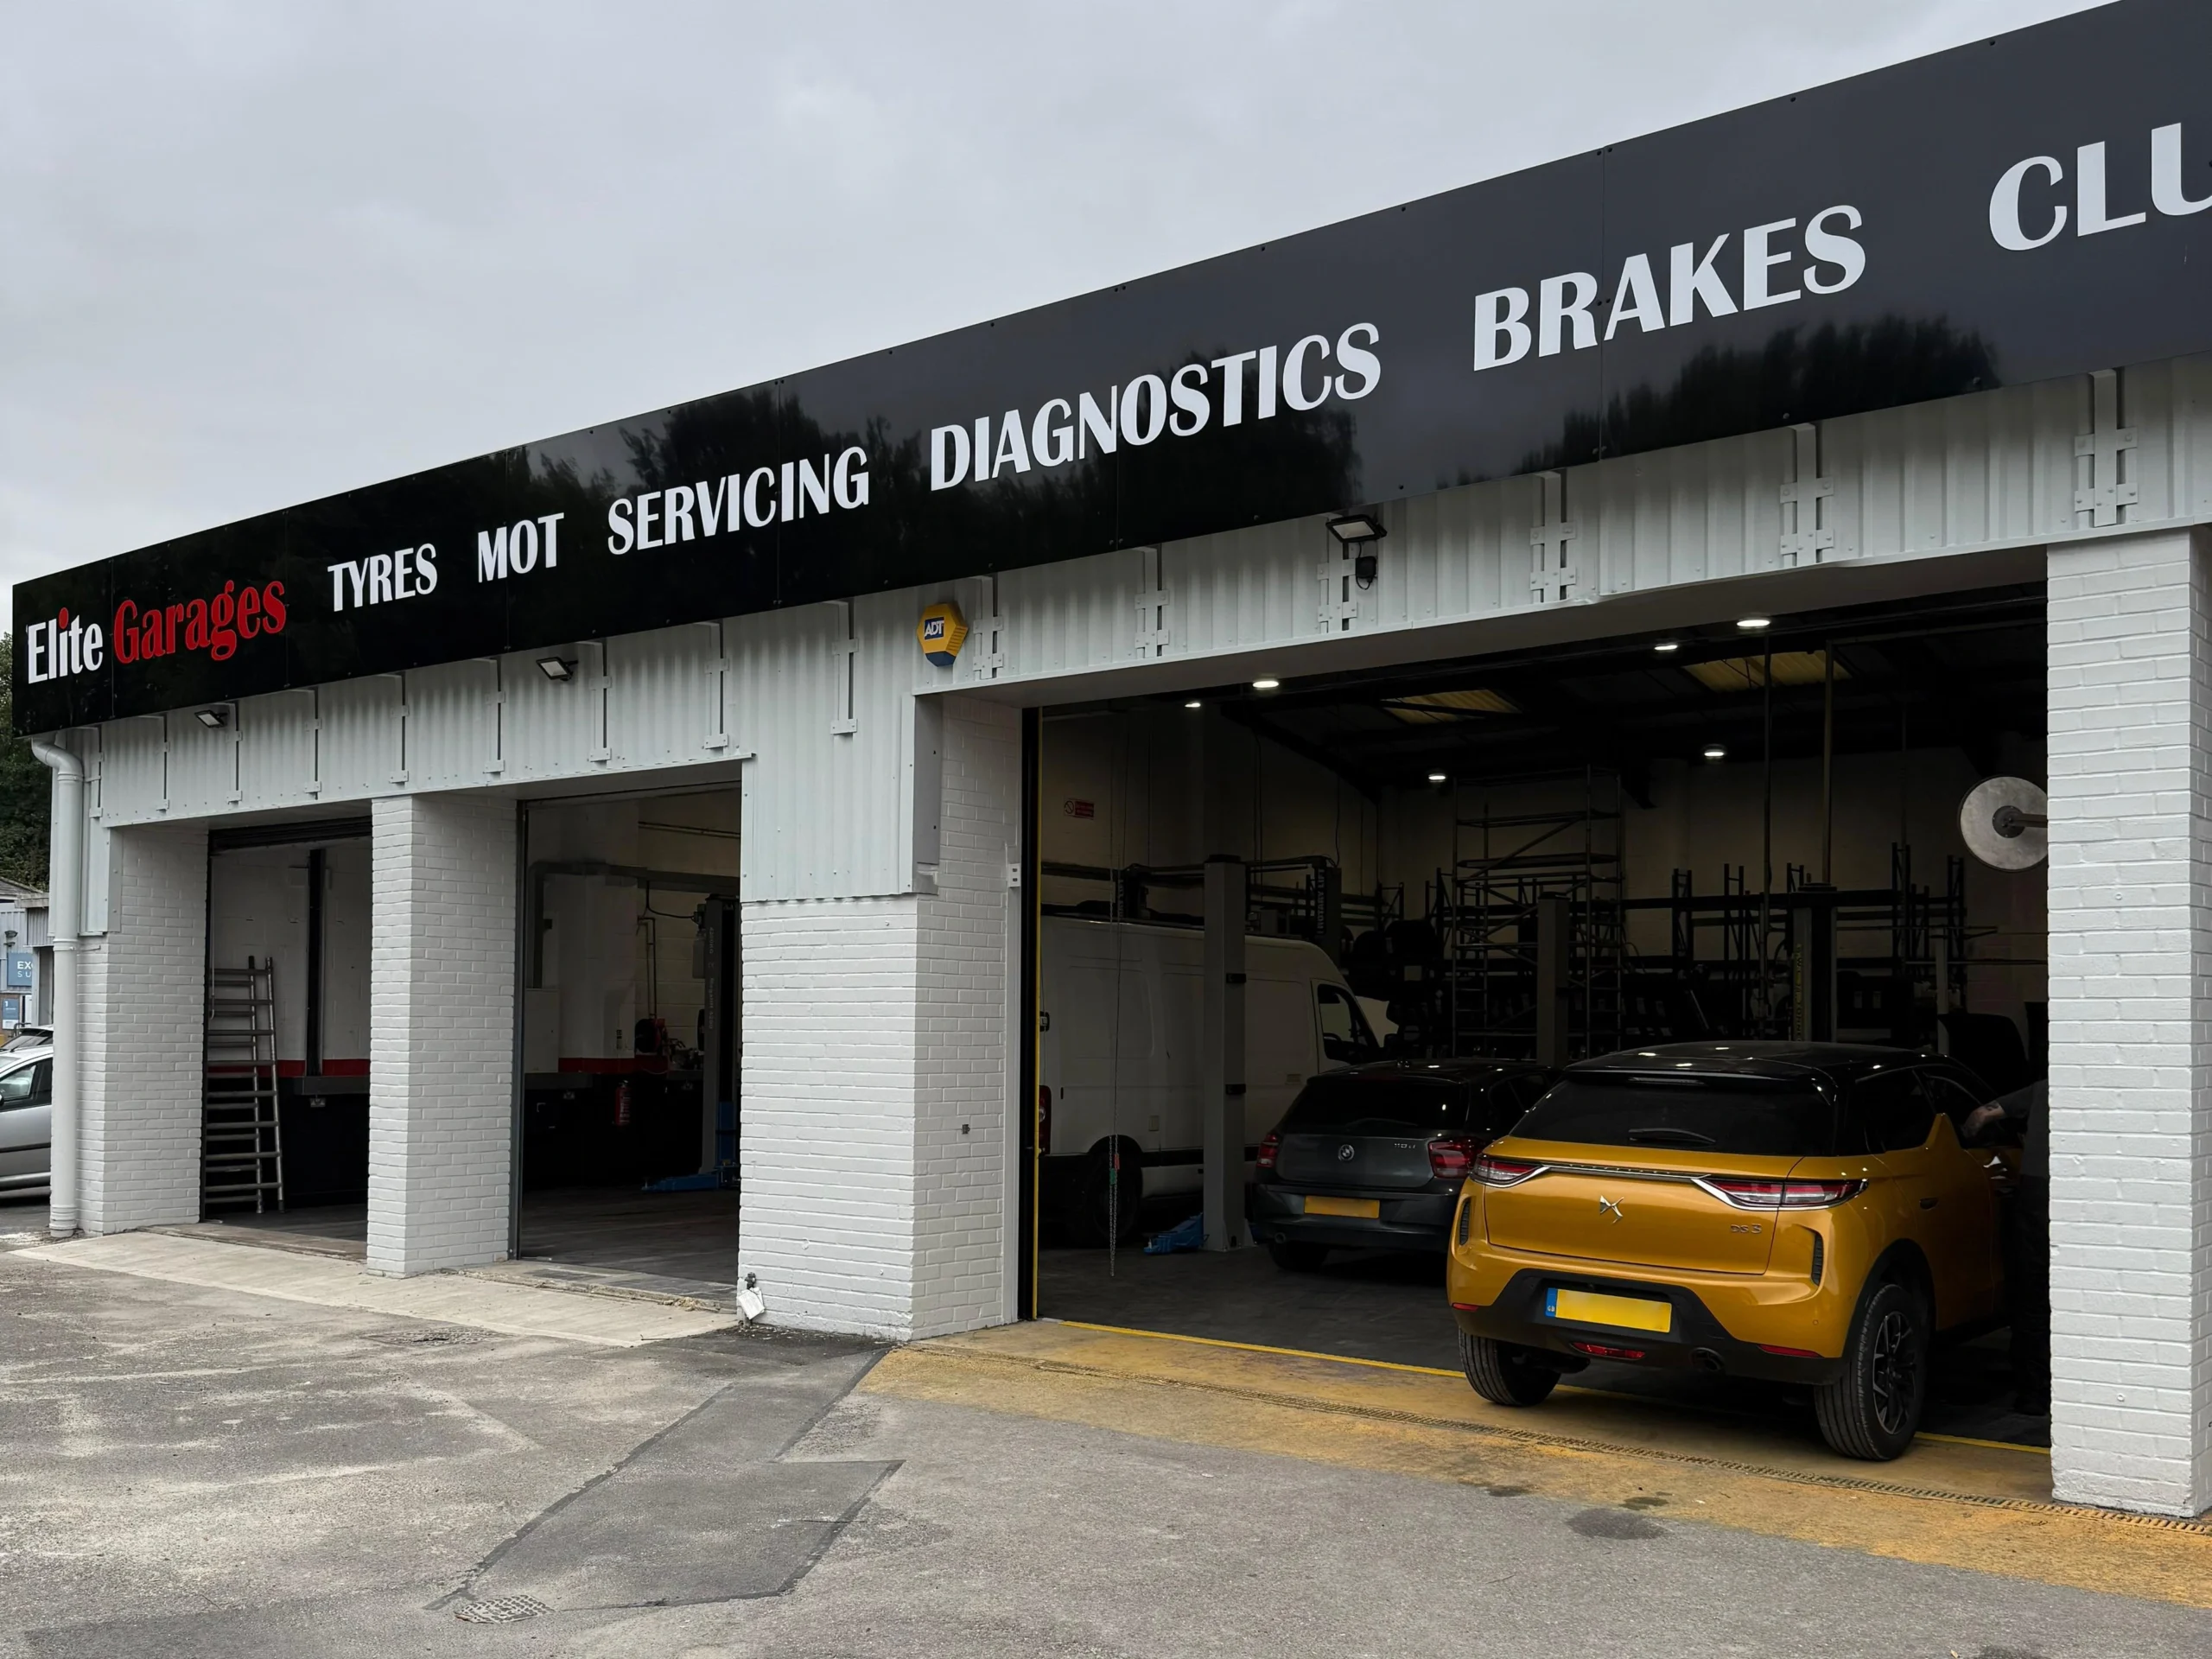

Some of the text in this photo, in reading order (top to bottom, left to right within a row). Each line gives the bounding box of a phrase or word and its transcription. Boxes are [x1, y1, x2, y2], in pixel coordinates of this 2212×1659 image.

[327, 122, 2212, 612] TYRES MOT SERVICING DIAGNOSTICS BRAKES CLU
[27, 579, 287, 684] Elite Garages
[925, 620, 944, 637] ADT
[17, 961, 33, 969] EX
